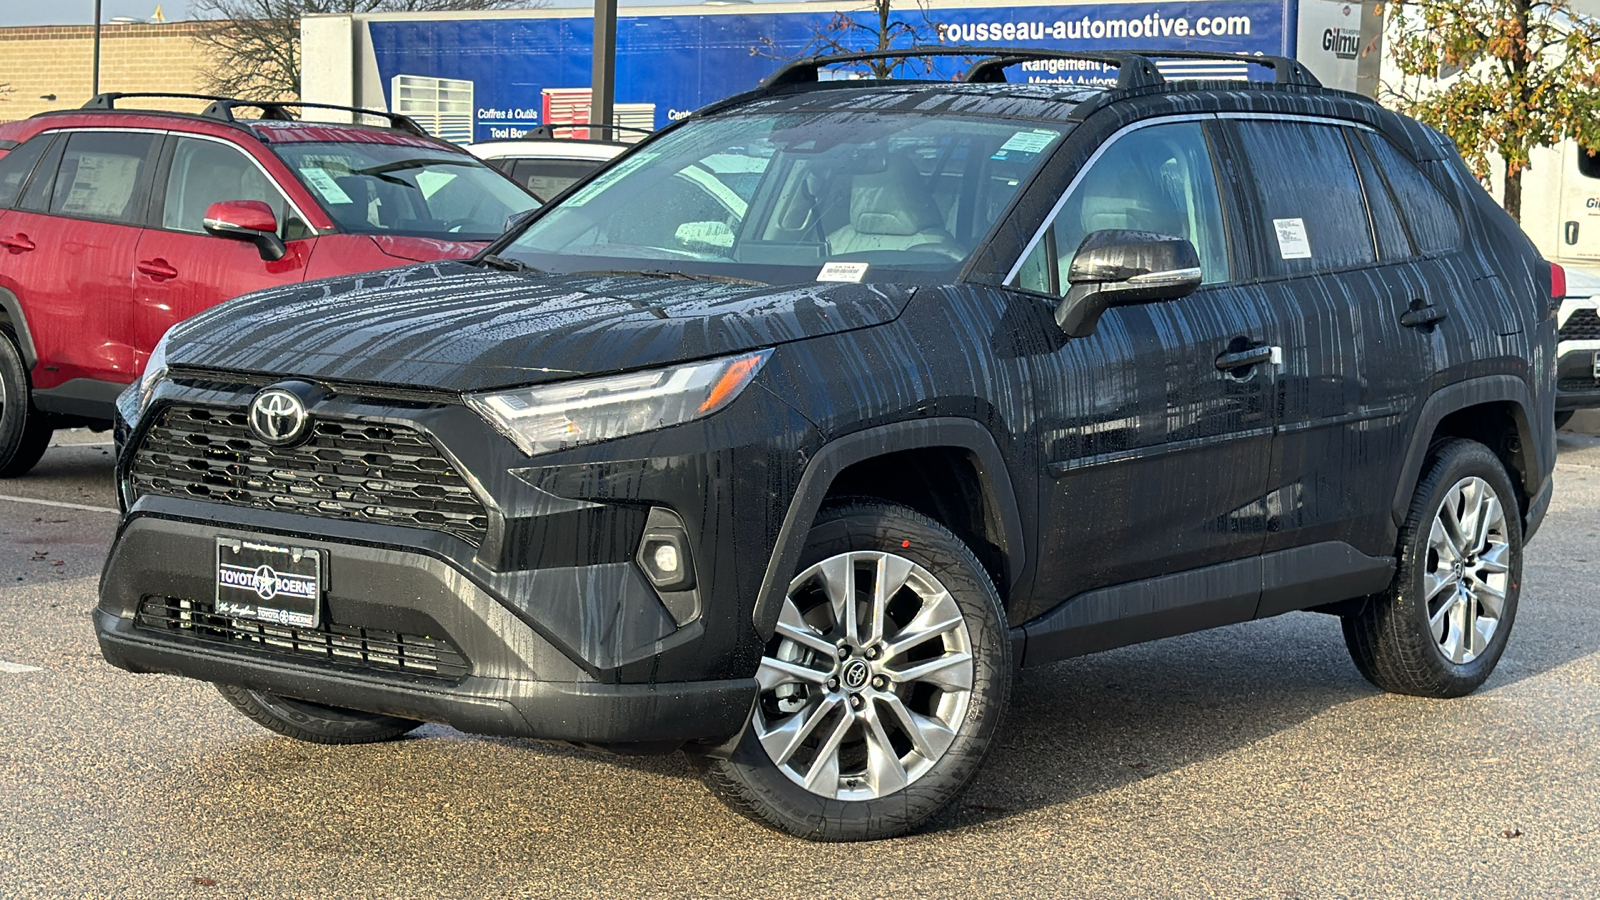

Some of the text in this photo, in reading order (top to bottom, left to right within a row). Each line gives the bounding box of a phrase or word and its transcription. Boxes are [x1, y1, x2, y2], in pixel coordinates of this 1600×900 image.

[939, 13, 1251, 42] rousseau-automotive.com
[1022, 59, 1100, 74] Rangement
[477, 108, 538, 119] Coffres à Outils
[490, 128, 509, 139] Tool
[220, 569, 316, 594] TOYOTA BOERNE
